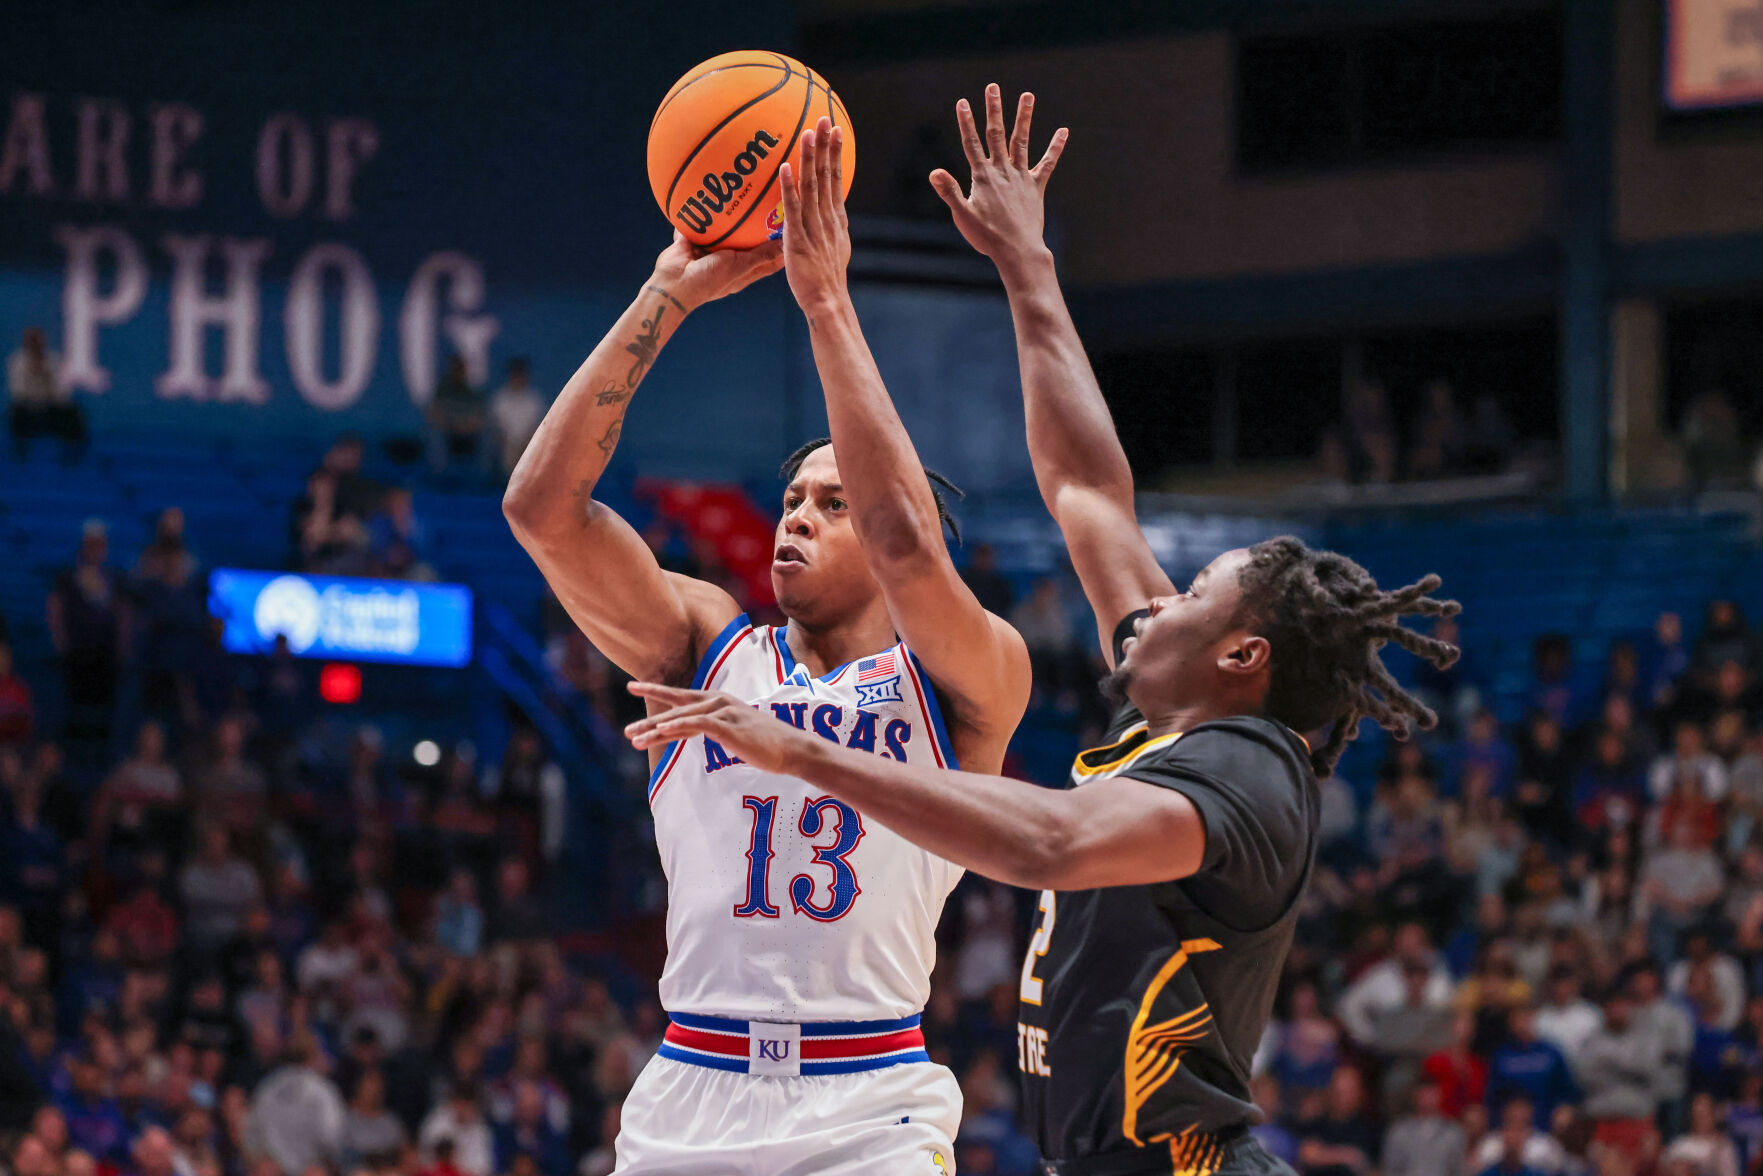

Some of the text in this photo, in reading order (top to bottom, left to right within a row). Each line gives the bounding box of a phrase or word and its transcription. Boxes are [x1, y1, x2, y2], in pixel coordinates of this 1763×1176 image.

[256, 112, 380, 220] OF
[676, 129, 779, 234] Wilson
[54, 224, 498, 410] PHOG
[733, 794, 867, 922] 13
[757, 1038, 791, 1062] KU
